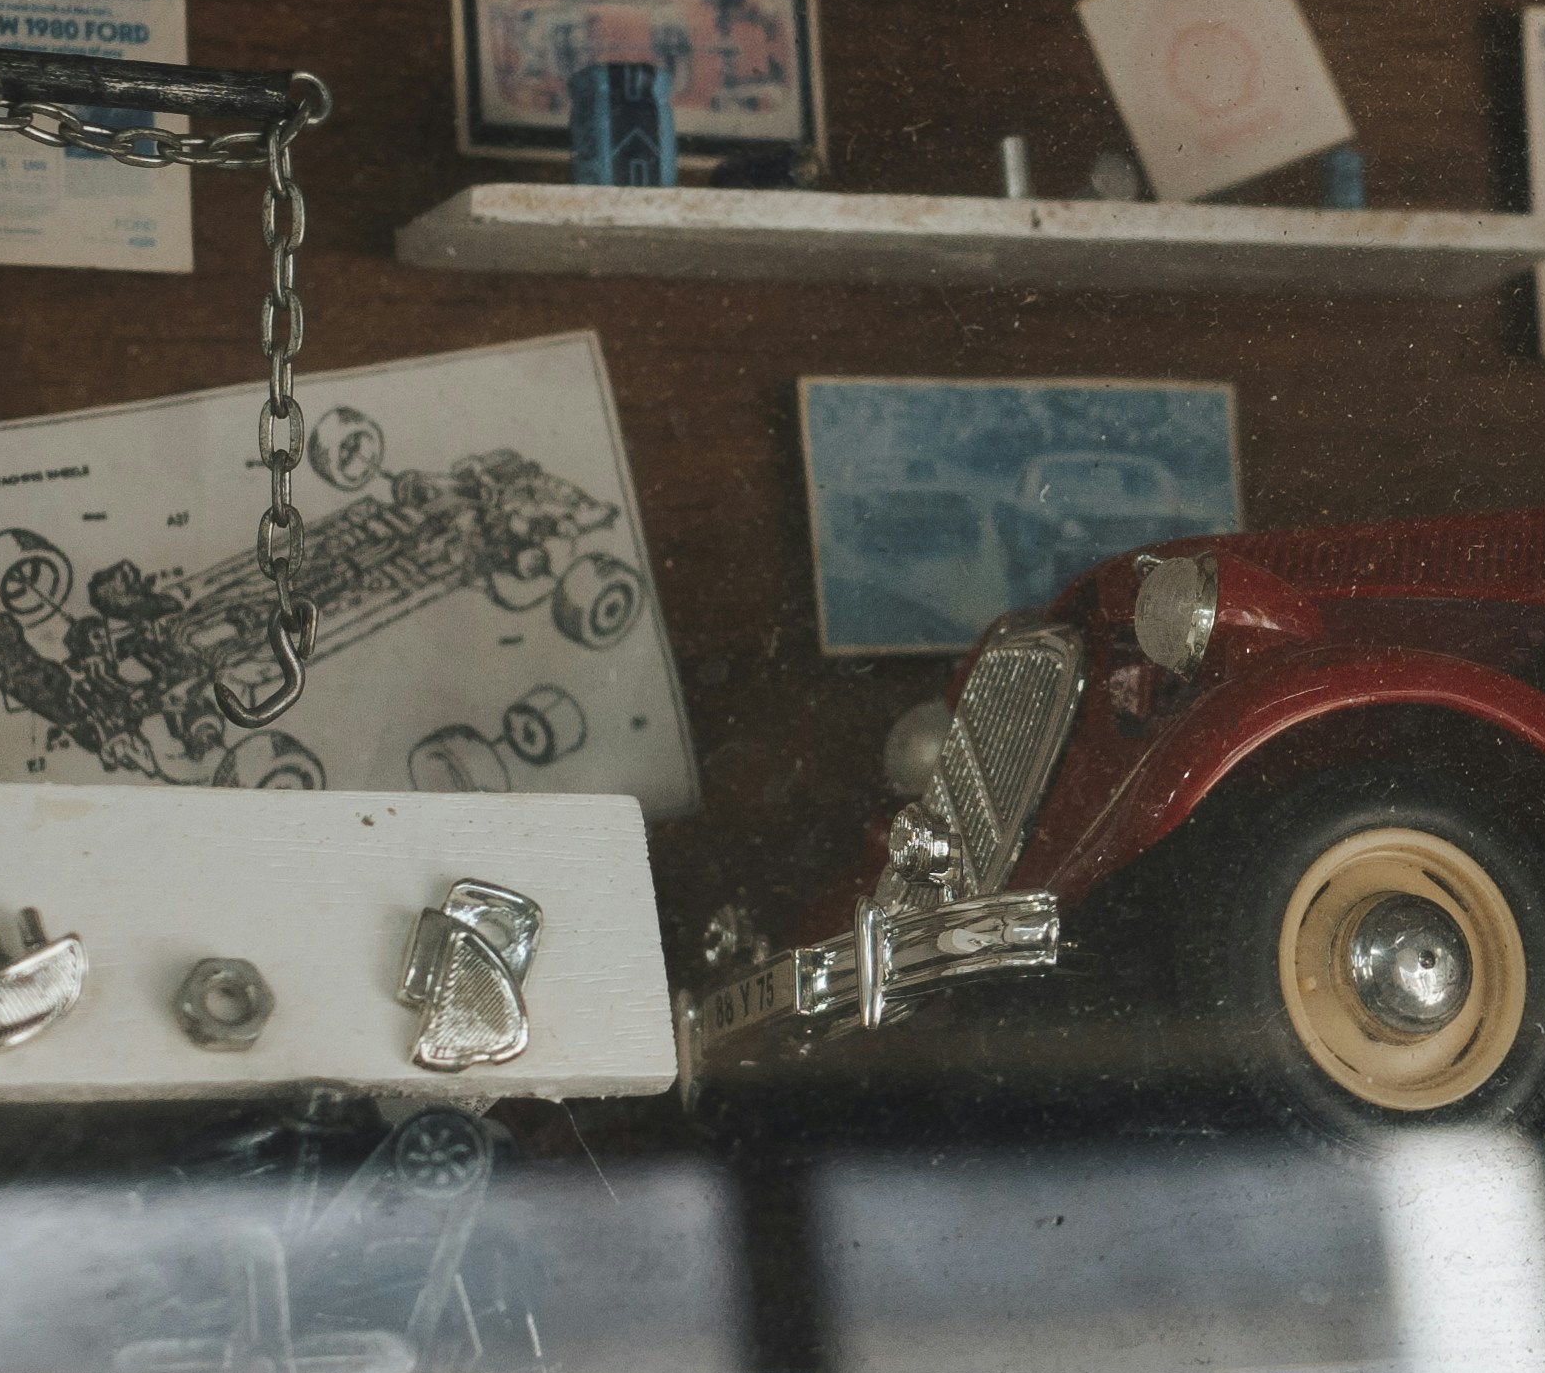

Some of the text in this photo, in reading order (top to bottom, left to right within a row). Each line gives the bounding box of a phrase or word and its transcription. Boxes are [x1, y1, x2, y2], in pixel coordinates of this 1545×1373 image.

[25, 17, 80, 39] 1980
[85, 21, 151, 45] FORD
[739, 981, 750, 1017] Y
[755, 971, 774, 1011] 75
